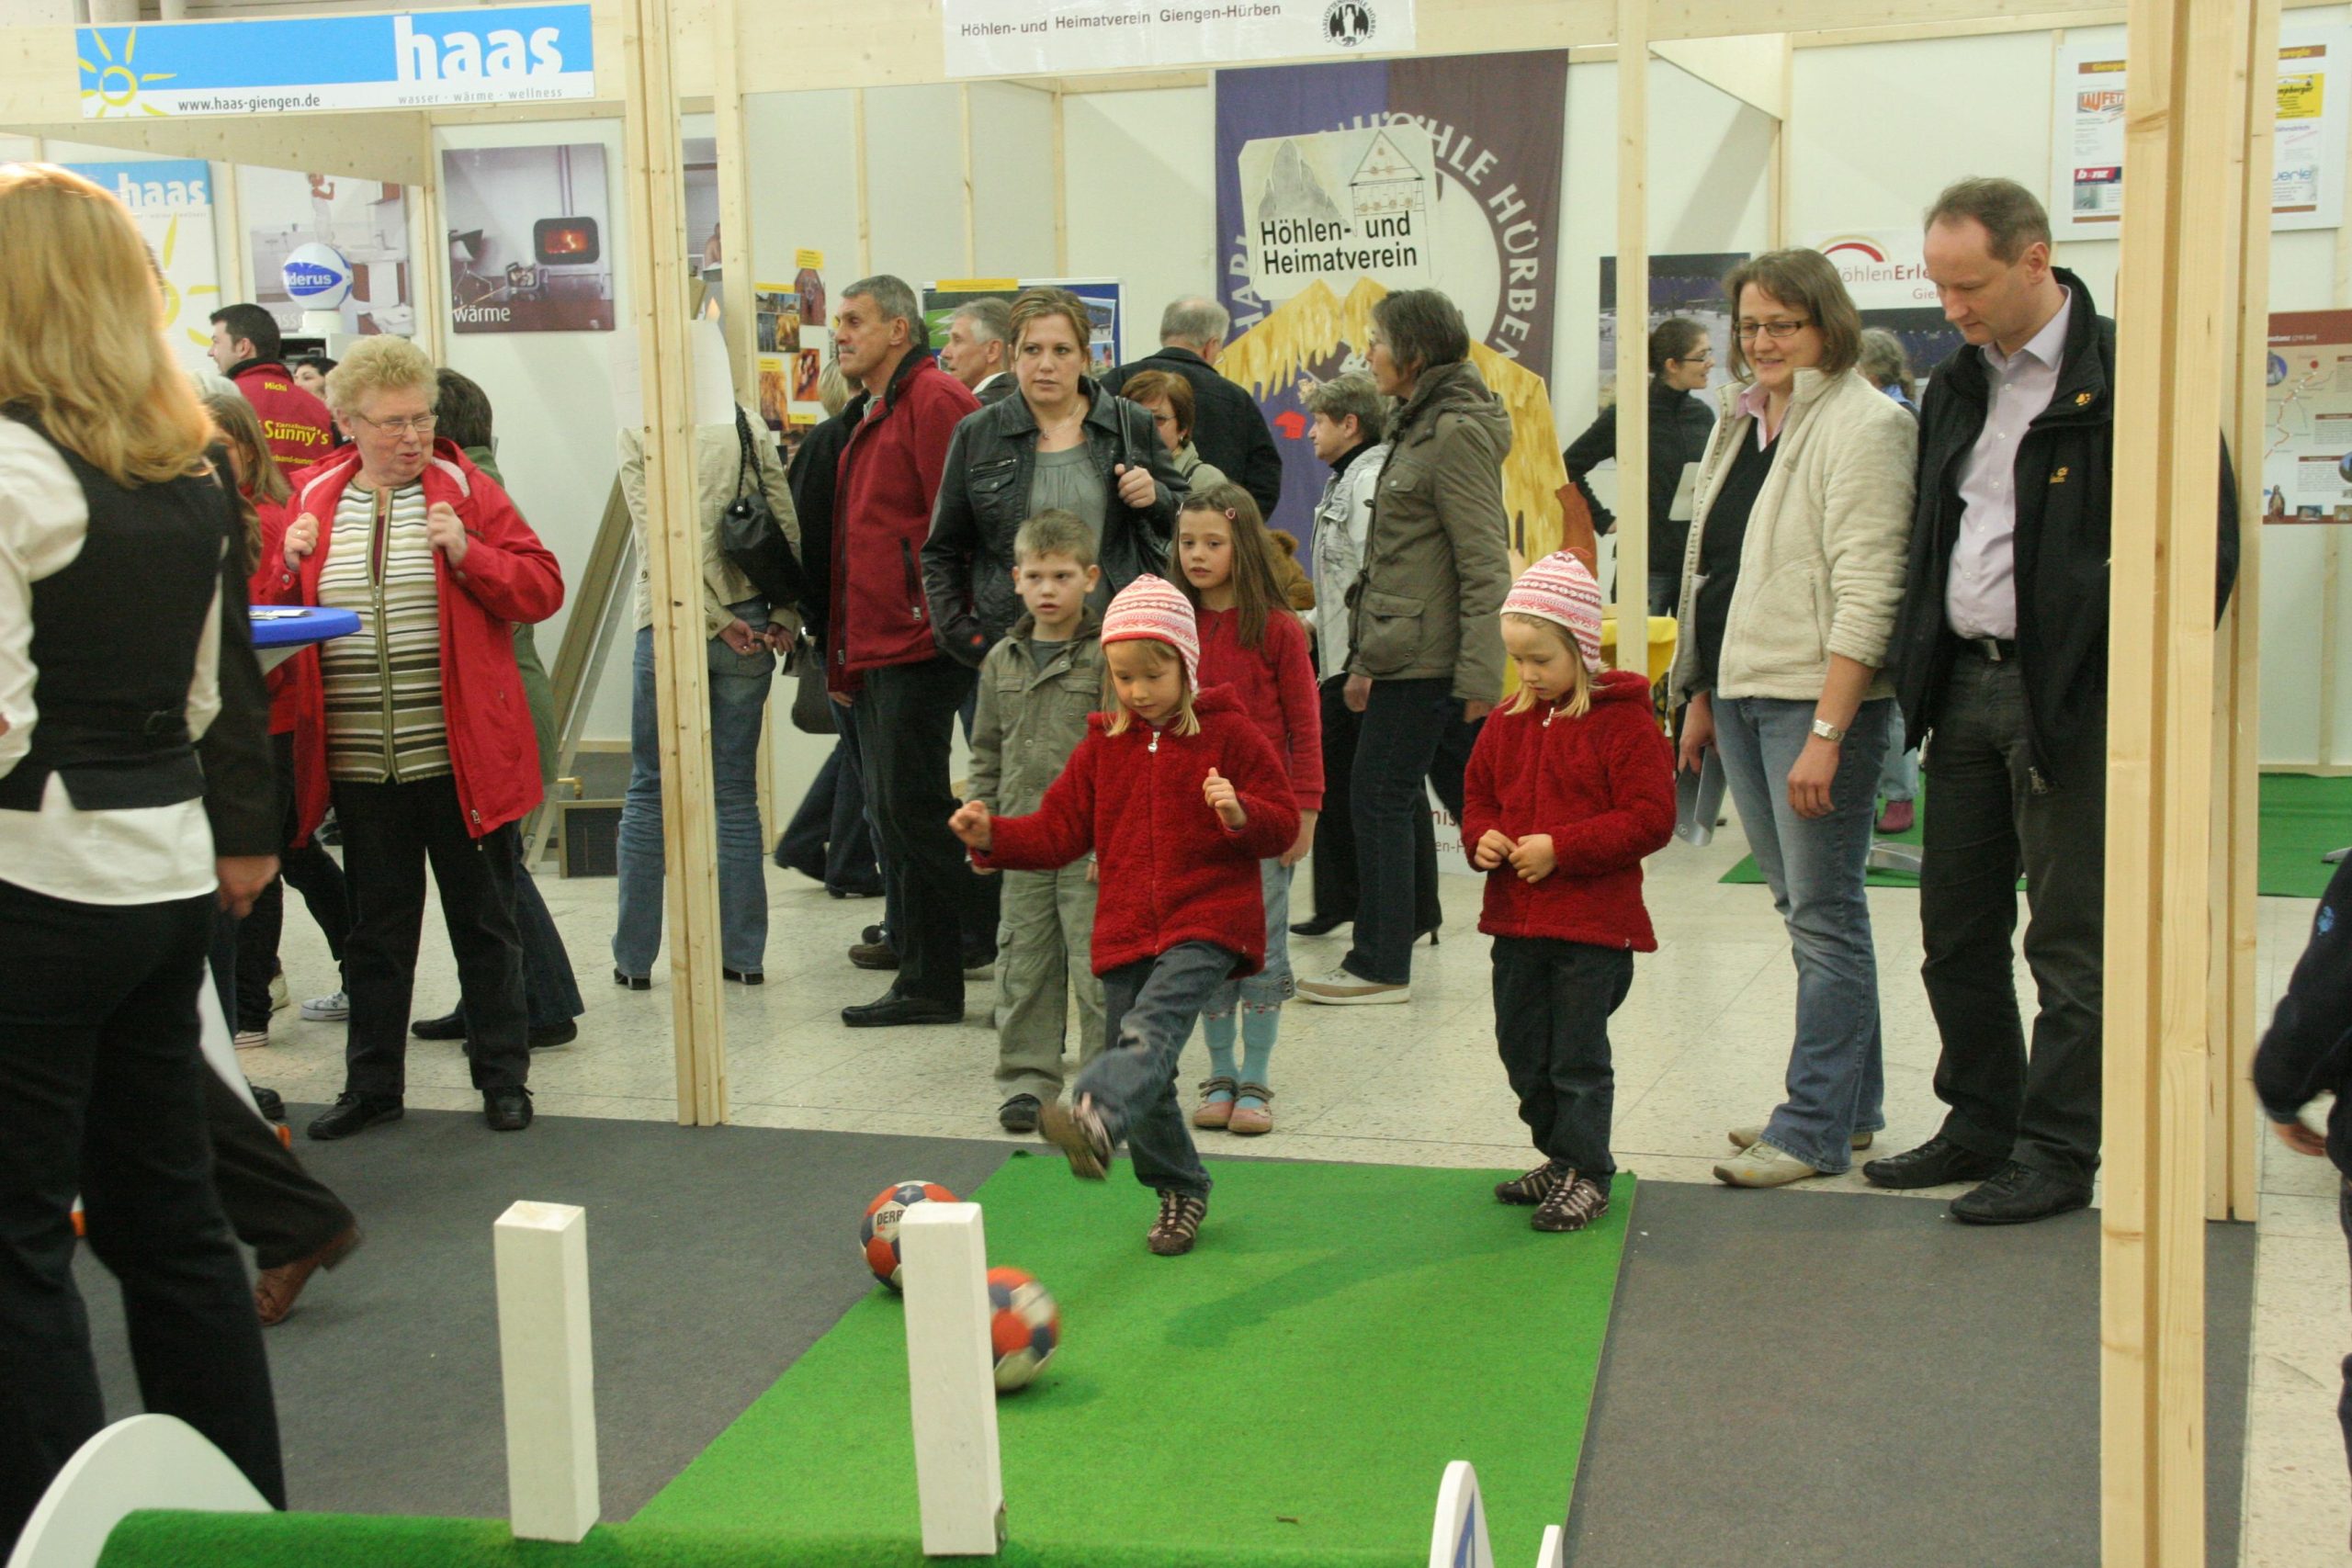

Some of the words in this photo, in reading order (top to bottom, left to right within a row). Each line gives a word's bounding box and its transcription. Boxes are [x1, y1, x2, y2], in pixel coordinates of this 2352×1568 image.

[961, 23, 1017, 37] Höhlen-
[1021, 19, 1047, 33] und
[1056, 11, 1151, 29] Heimatverein
[1159, 4, 1282, 23] Giengen-Hürben
[393, 16, 563, 81] haas
[178, 93, 321, 112] www.haas-giengen.de
[398, 94, 439, 105] wasser
[453, 90, 493, 102] wärme
[508, 87, 563, 100] wellness
[118, 173, 206, 208] haas
[1261, 217, 1351, 246] Höhlen-
[1365, 210, 1411, 240] und
[1263, 242, 1418, 275] Heimatverein
[284, 272, 333, 287] derus
[1838, 264, 1930, 283] öhlenErle
[453, 305, 512, 322] wärme
[264, 420, 329, 446] Sunny's
